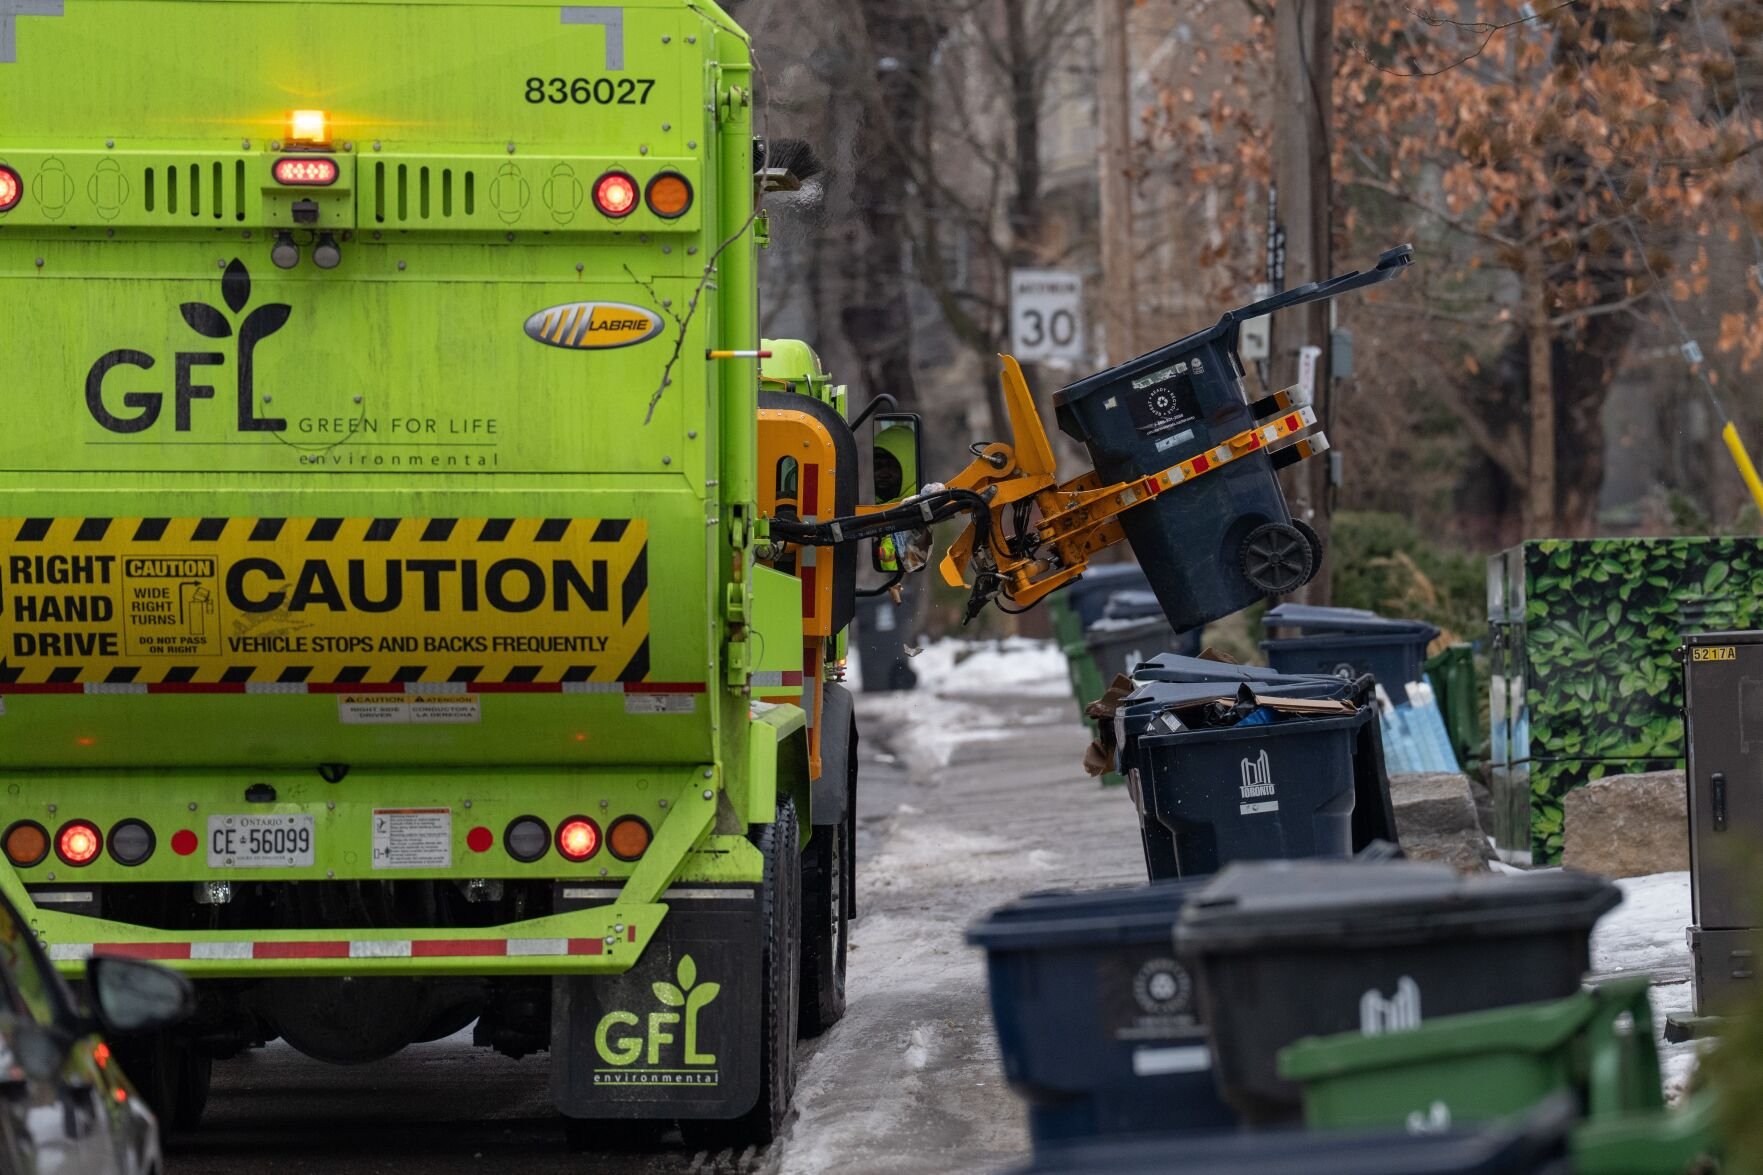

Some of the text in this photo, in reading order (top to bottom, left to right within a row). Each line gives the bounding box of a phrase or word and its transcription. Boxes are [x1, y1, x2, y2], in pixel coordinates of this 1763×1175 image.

[524, 77, 656, 105] 836027
[588, 319, 649, 332] LABRIE
[1021, 309, 1075, 348] 30
[85, 303, 292, 433] GFL
[299, 417, 497, 434] GREEN FOR LIFE
[299, 453, 498, 466] environmental
[9, 555, 116, 585] RIGHT
[129, 560, 211, 577] CAUTION
[133, 587, 171, 599] WIDE
[225, 557, 609, 613] CAUTION
[14, 595, 114, 623] HAND
[131, 601, 174, 612] RIGHT
[130, 614, 177, 625] TURNS
[13, 632, 120, 657] DRIVE
[139, 636, 207, 645] DO NOT PASS
[228, 635, 609, 654] VEHICLE STOPS AND BACKS FREQUENTLY
[149, 646, 198, 654] ON RIGHT
[1694, 647, 1735, 660] 5217A
[357, 696, 405, 704] CAUTION
[1239, 784, 1275, 799] TORONTO
[241, 818, 282, 827] ONTARIO
[213, 827, 309, 855] CE 56099
[594, 982, 721, 1067] GFL
[593, 1072, 719, 1083] environmental
